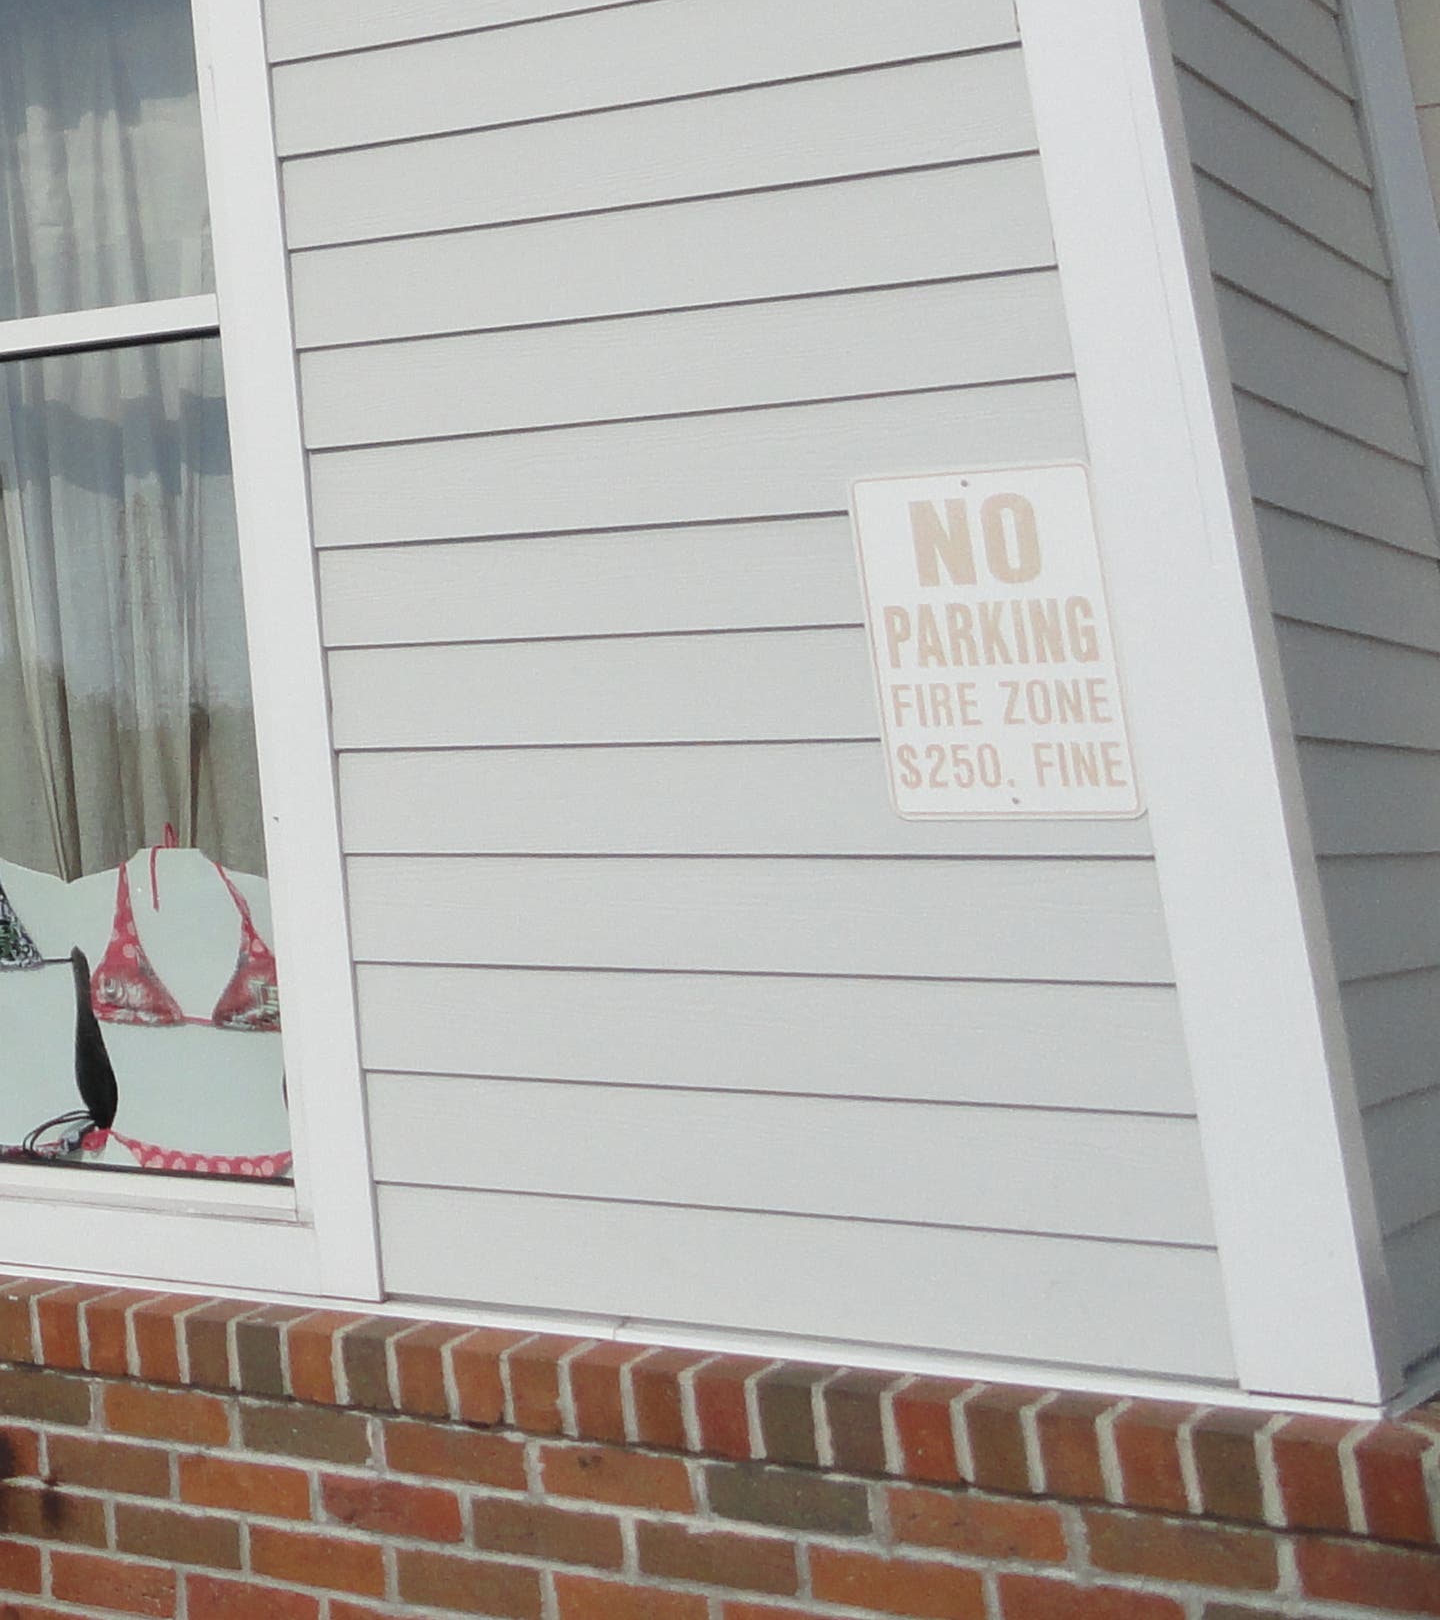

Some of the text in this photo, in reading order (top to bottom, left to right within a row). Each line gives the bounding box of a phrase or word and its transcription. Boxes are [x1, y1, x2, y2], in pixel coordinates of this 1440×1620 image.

[908, 492, 1043, 587] NO
[883, 595, 1100, 669] PARKING
[890, 678, 1113, 728] FIRE ZONE
[896, 741, 1128, 789] $250. FINE
